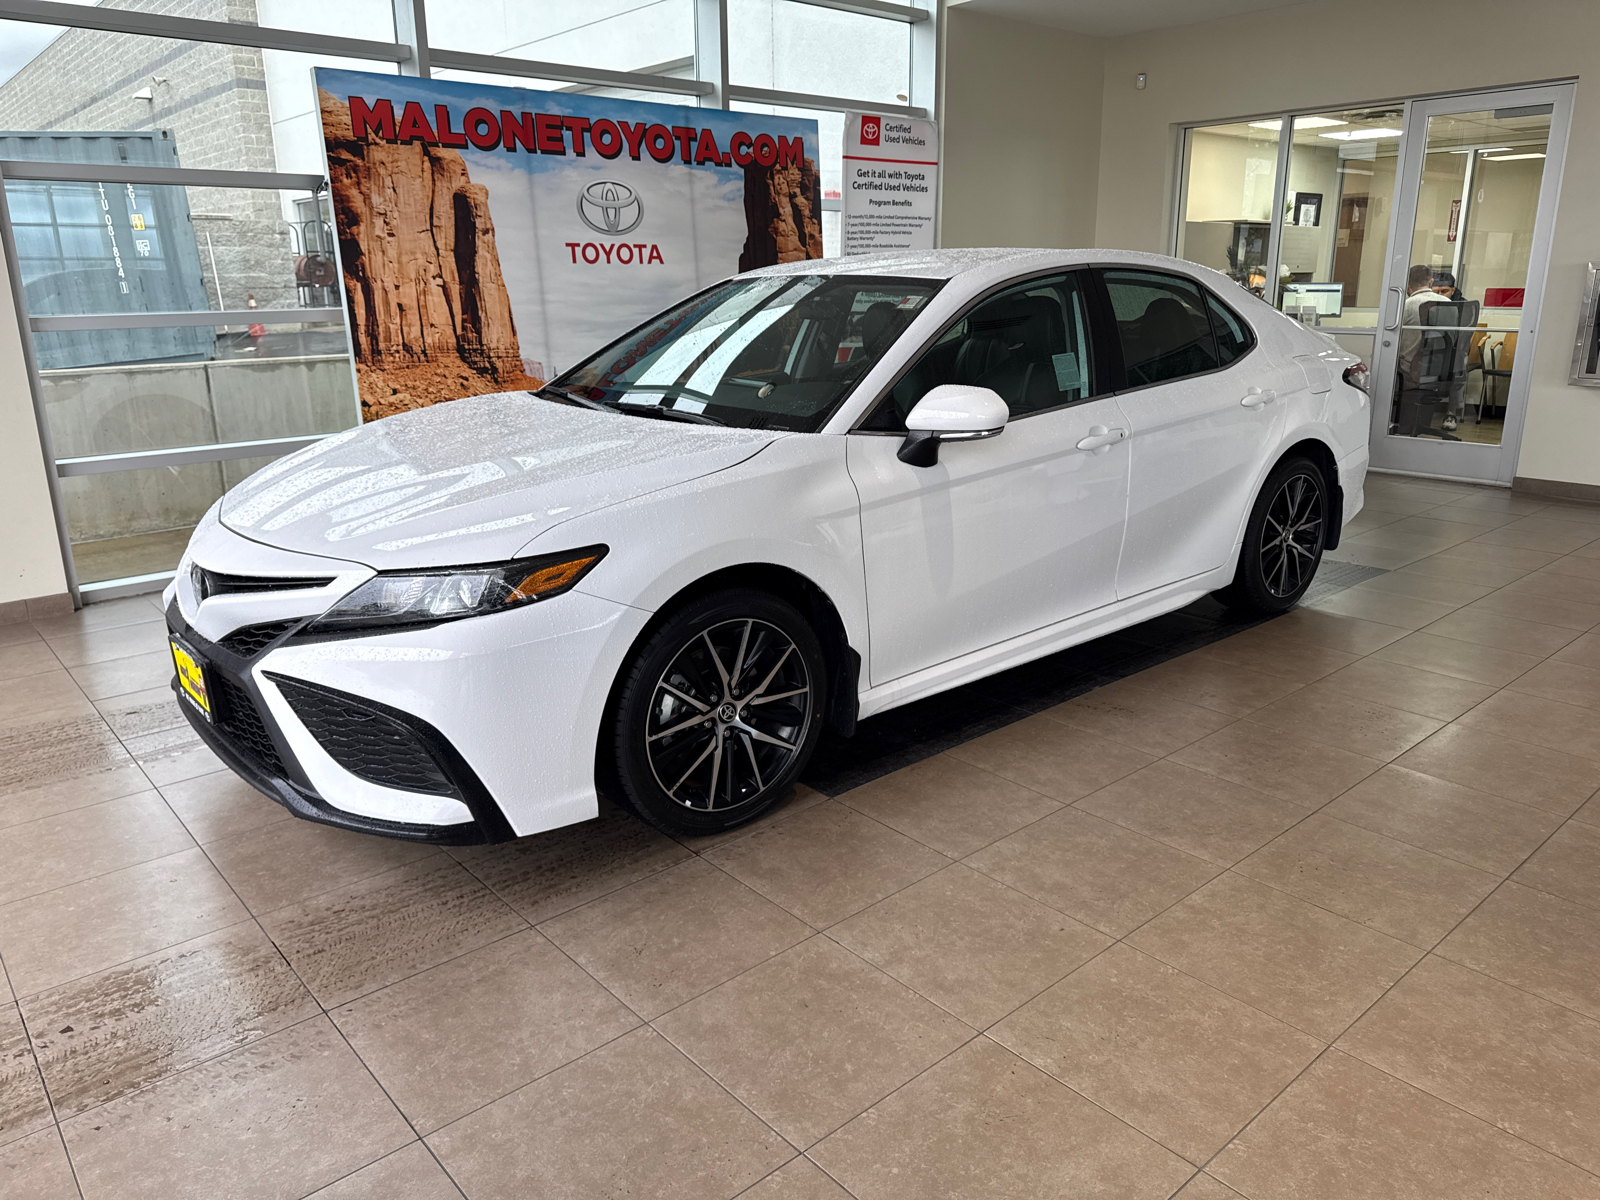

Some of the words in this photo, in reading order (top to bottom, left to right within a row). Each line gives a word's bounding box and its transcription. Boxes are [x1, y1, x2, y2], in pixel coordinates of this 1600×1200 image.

[348, 96, 804, 169] MALONETOYOTA.COM
[884, 123, 911, 134] Certified
[884, 134, 900, 144] Used
[902, 136, 926, 146] Vehicles
[857, 169, 870, 178] Get
[871, 169, 877, 178] it
[878, 170, 886, 179] all
[888, 170, 902, 180] with
[904, 171, 925, 183] Toyota
[852, 181, 882, 190] Certified
[884, 183, 900, 191] Used
[902, 184, 928, 192] Vehicles
[869, 199, 891, 207] Program
[105, 214, 124, 278] 081884
[565, 242, 664, 265] TOYOTA
